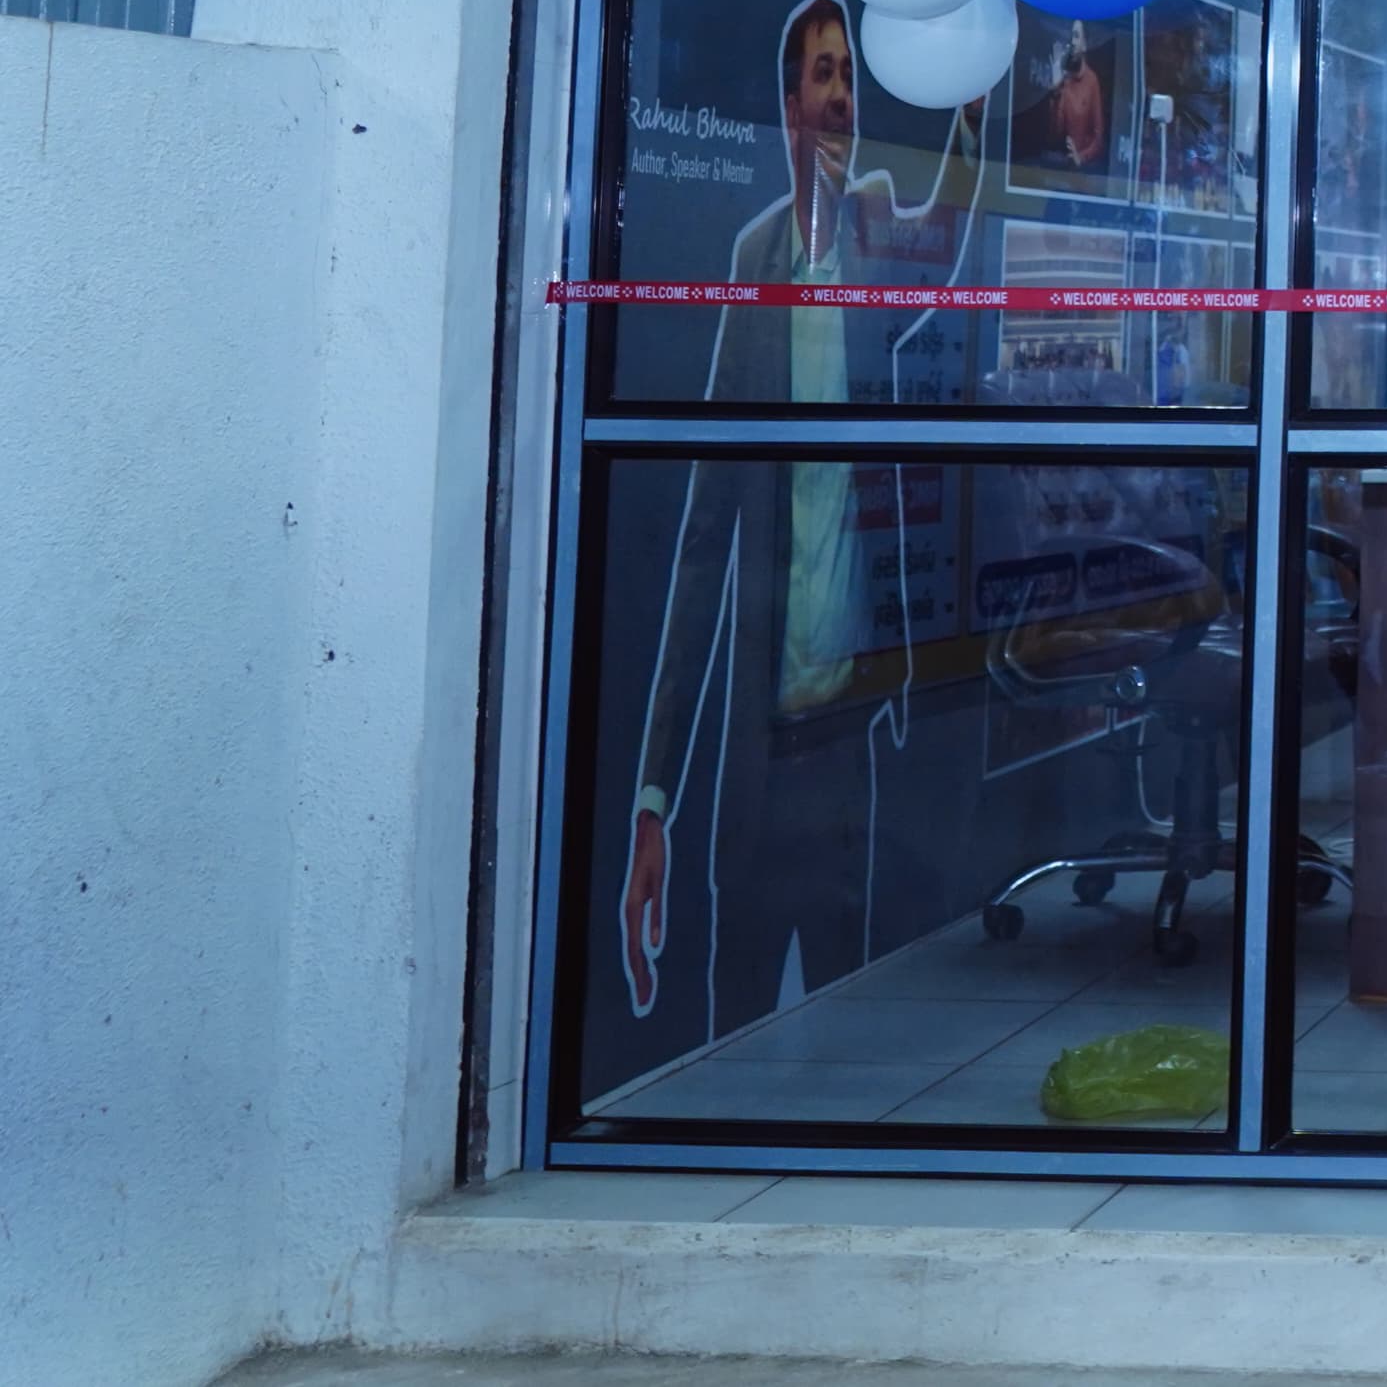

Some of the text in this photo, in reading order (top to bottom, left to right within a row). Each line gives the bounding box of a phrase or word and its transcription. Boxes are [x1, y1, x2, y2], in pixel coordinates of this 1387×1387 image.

[630, 97, 757, 145] Rahul Bhuva
[632, 147, 669, 179] Author,
[670, 151, 711, 183] Speaker
[722, 158, 755, 185] Mentor
[566, 286, 620, 298] WELCOME
[705, 287, 759, 301] WELCOME
[813, 289, 868, 303] WELCOME
[953, 292, 1008, 305] WELCOME
[1063, 293, 1118, 306] WELCOME
[1203, 293, 1259, 307] WELCOME
[1316, 294, 1371, 308] WELCOME
